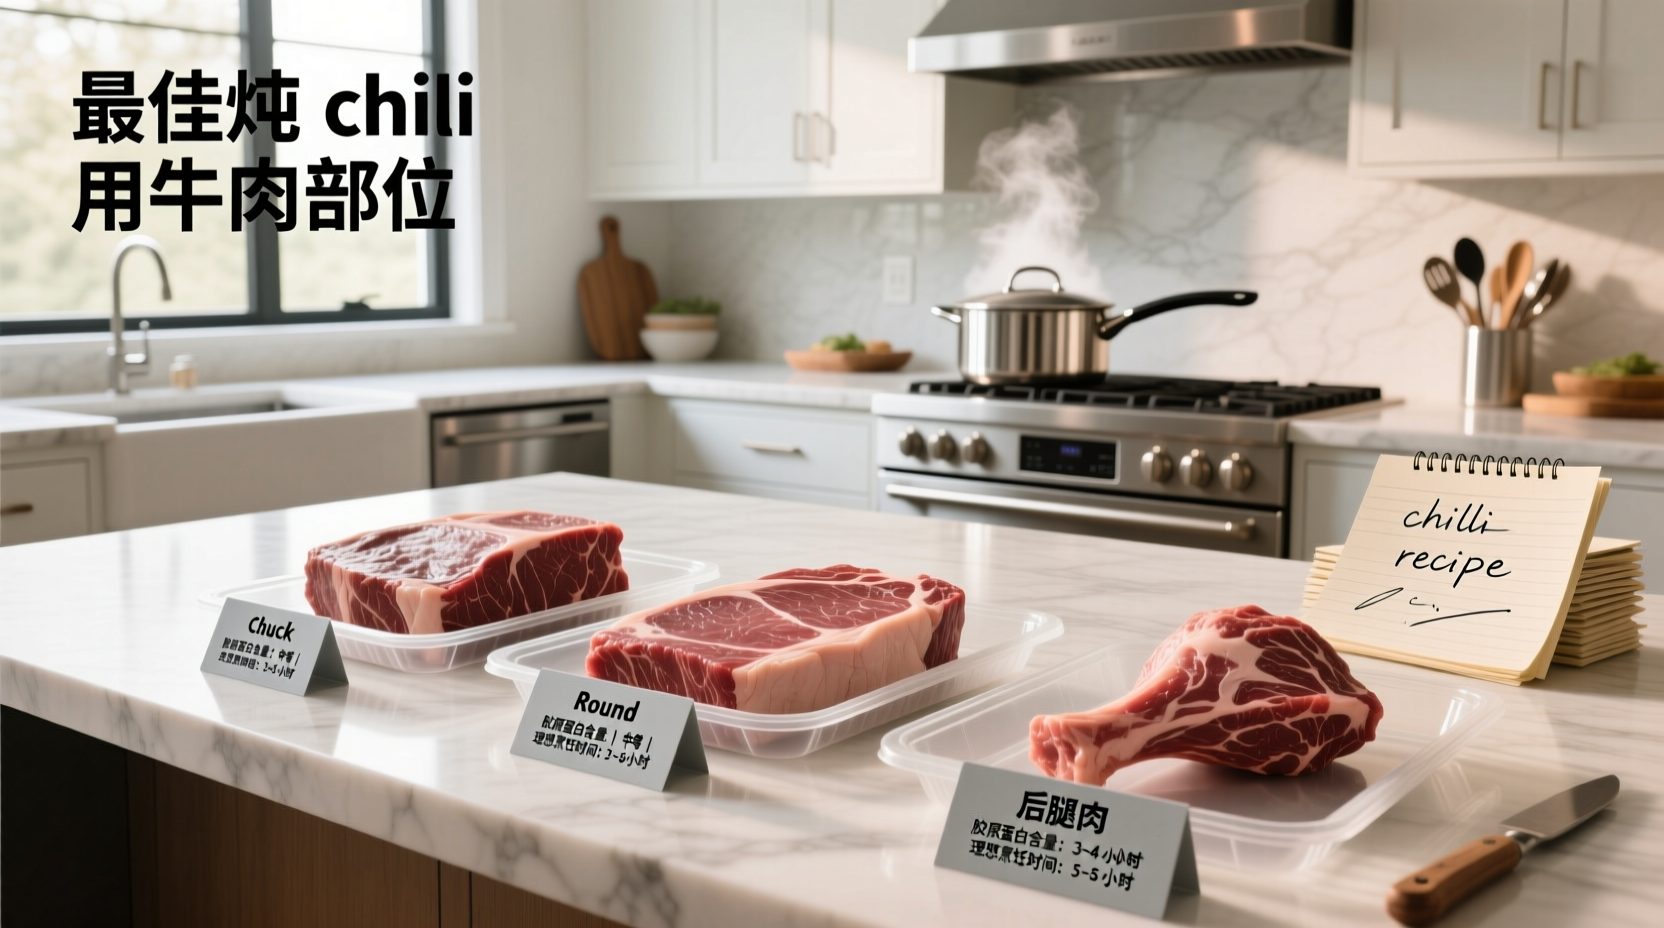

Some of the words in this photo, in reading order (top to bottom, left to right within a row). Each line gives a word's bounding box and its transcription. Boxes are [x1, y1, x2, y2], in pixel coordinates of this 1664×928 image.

[1403, 498, 1509, 534] chilli
[1395, 550, 1512, 588] recipe
[248, 616, 295, 642] Chuck
[574, 690, 641, 722] Round
[1016, 790, 1109, 835] 后腿肉
